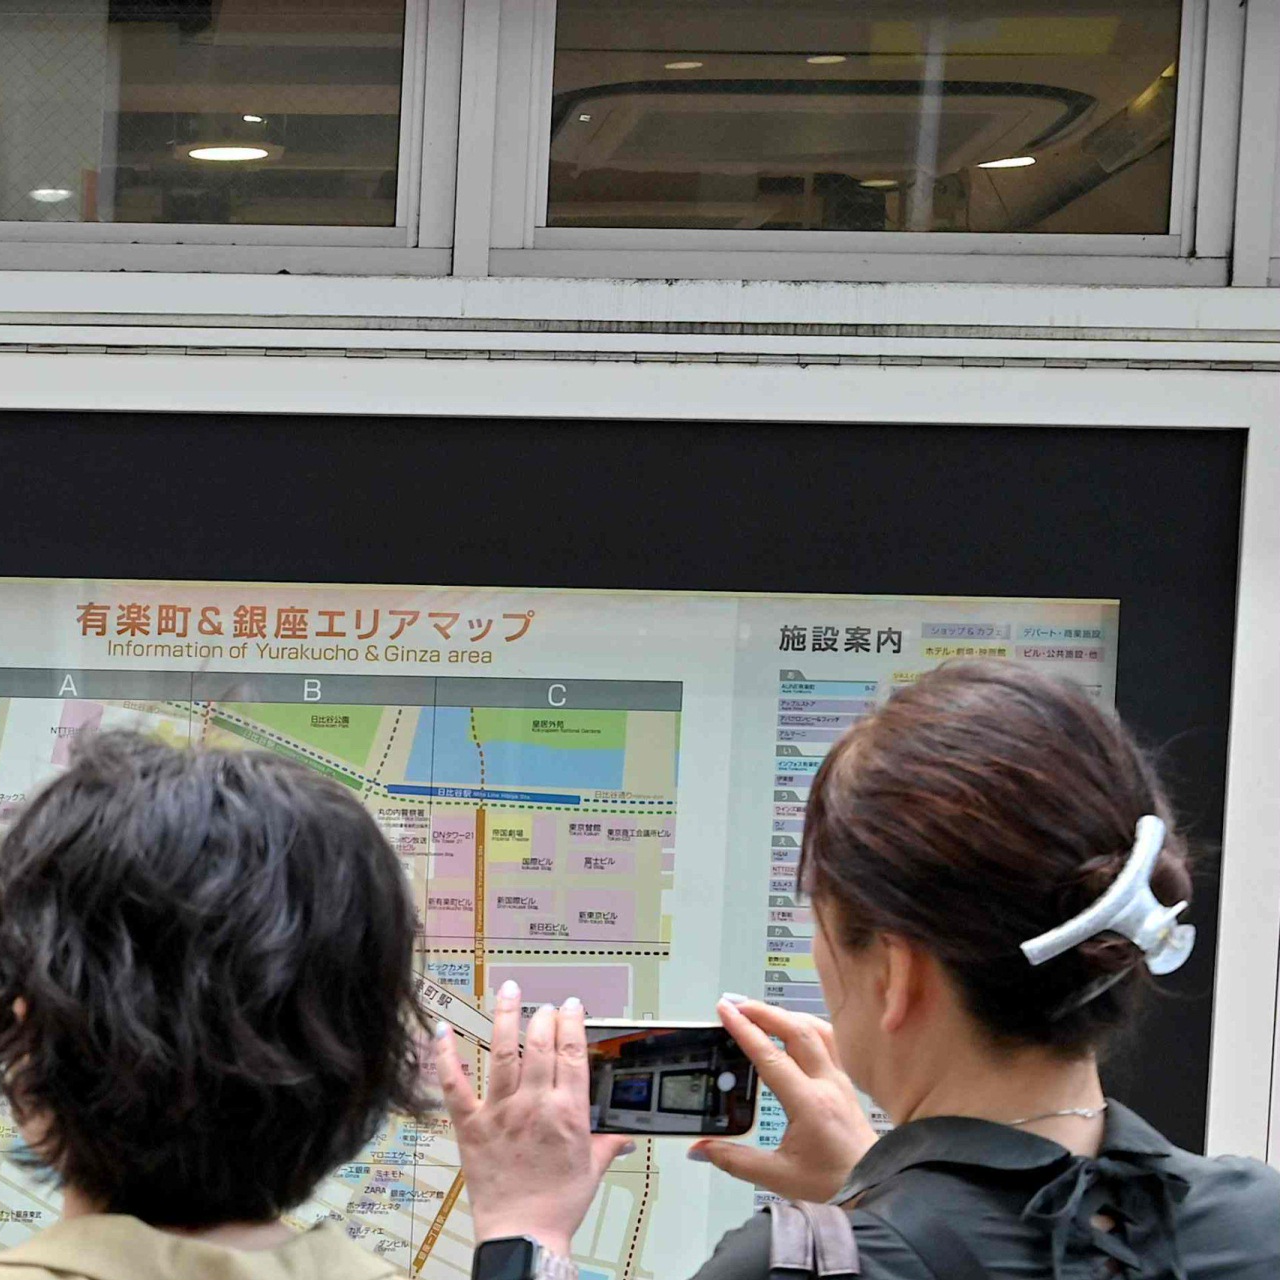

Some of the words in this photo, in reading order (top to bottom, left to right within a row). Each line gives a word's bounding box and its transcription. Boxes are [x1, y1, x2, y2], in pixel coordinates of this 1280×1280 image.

[75, 601, 536, 643] 有楽町&銀座エリアマップ
[107, 639, 223, 659] Information
[229, 642, 249, 660] of
[255, 643, 359, 662] Yurakucho
[364, 645, 380, 662] &
[385, 645, 440, 663] Ginza
[448, 648, 493, 664] area
[778, 625, 904, 654] 施設案内
[58, 673, 78, 696] A
[303, 678, 322, 701] B
[547, 683, 567, 706] C
[311, 715, 350, 724] 日比谷公園
[364, 1186, 387, 1195] ZARA
